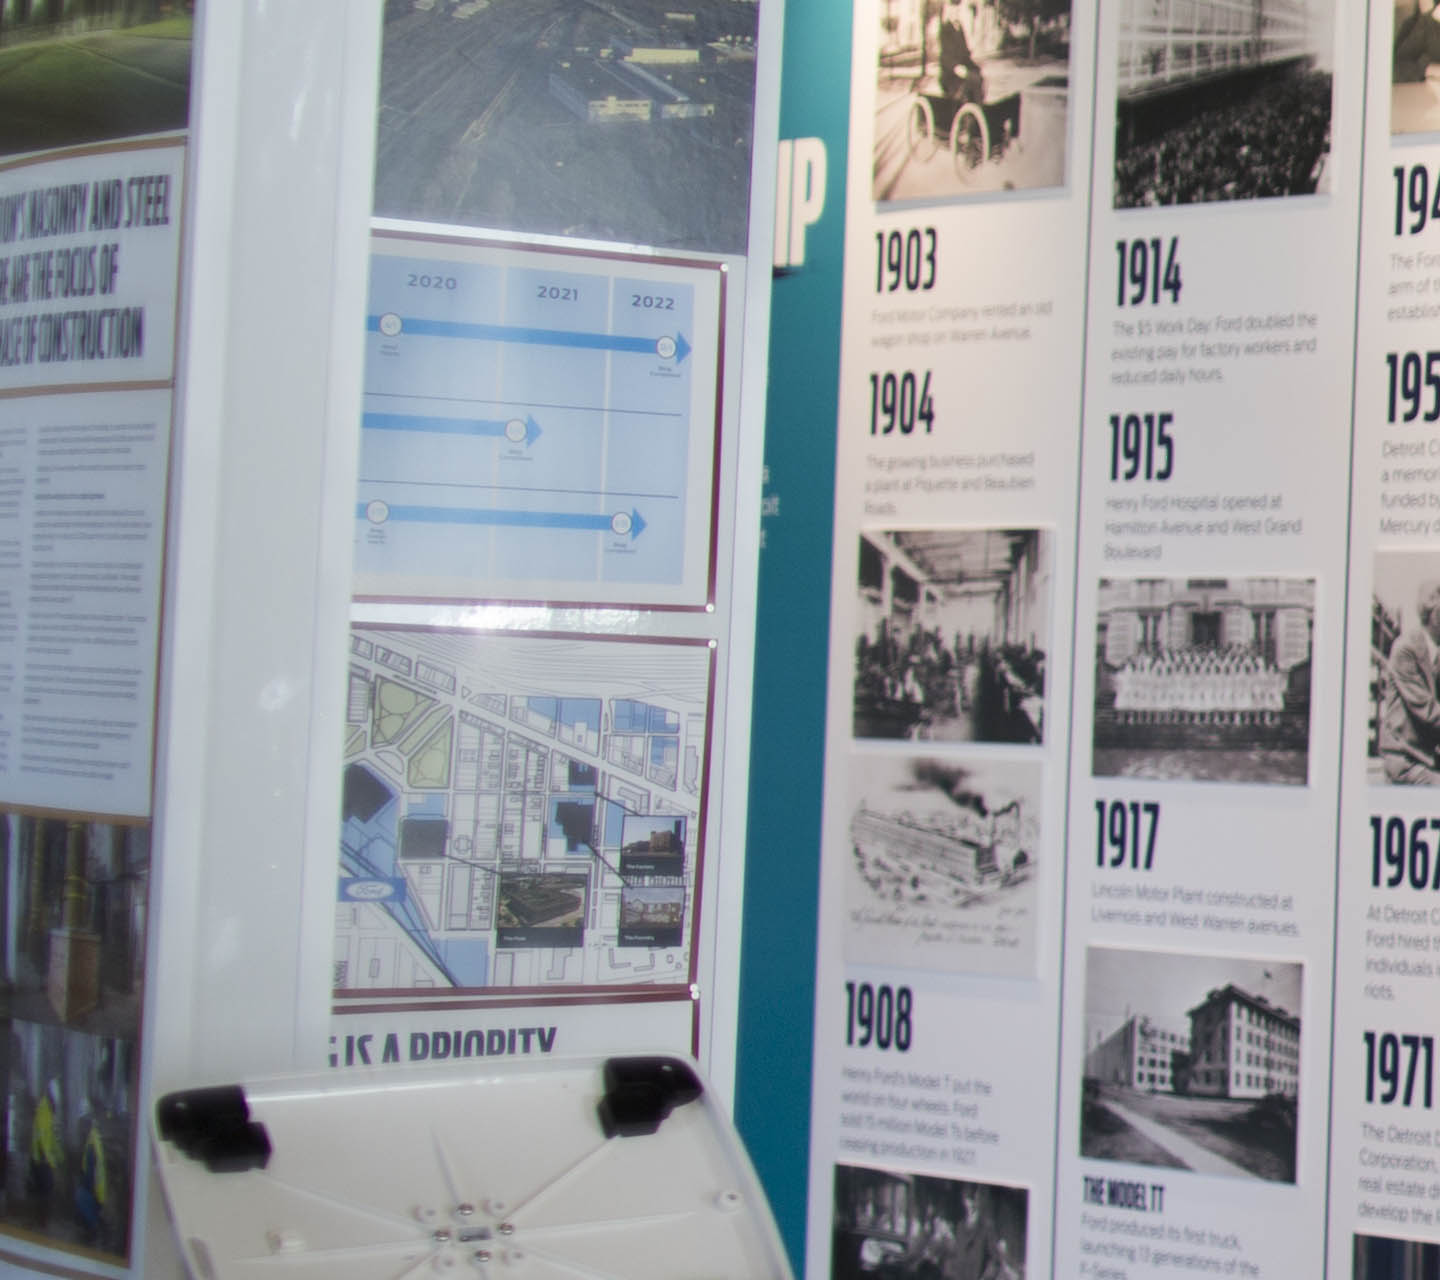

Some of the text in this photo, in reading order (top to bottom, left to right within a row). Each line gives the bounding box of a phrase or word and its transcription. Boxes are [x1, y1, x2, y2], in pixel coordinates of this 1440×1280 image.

[89, 179, 123, 231] AND
[124, 174, 171, 228] STEEL
[99, 243, 119, 295] OF
[407, 273, 676, 311] 2020 2021 2022
[874, 227, 939, 294] 1903
[1115, 235, 1183, 307] 1914
[869, 368, 936, 437] 1904
[1108, 412, 1175, 482] 1915
[1094, 799, 1161, 870] 1917
[844, 980, 914, 1053] 1908
[1363, 1030, 1435, 1110] 1971
[1083, 1175, 1105, 1205] THE
